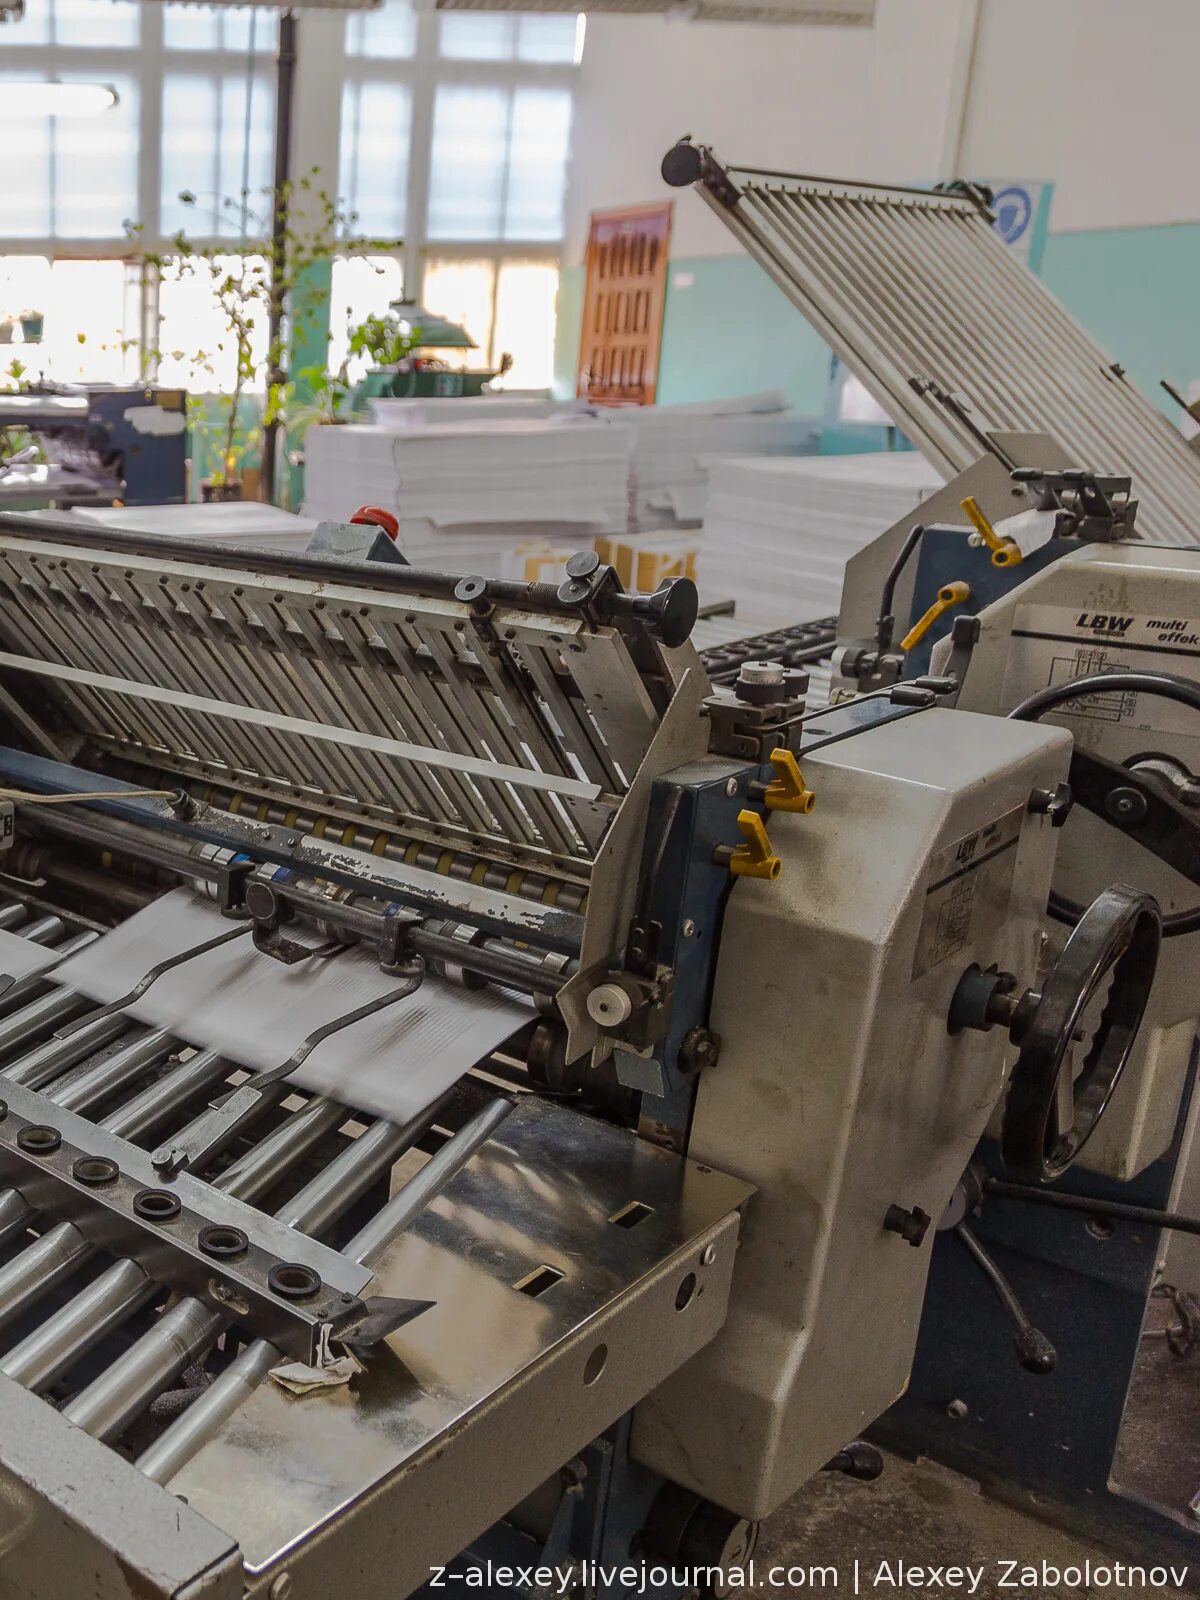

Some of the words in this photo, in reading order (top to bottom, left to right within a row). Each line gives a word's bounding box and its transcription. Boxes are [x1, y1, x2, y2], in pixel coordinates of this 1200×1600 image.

[1076, 613, 1134, 631] LBW
[1146, 620, 1189, 631] multi
[1158, 632, 1200, 645] effek
